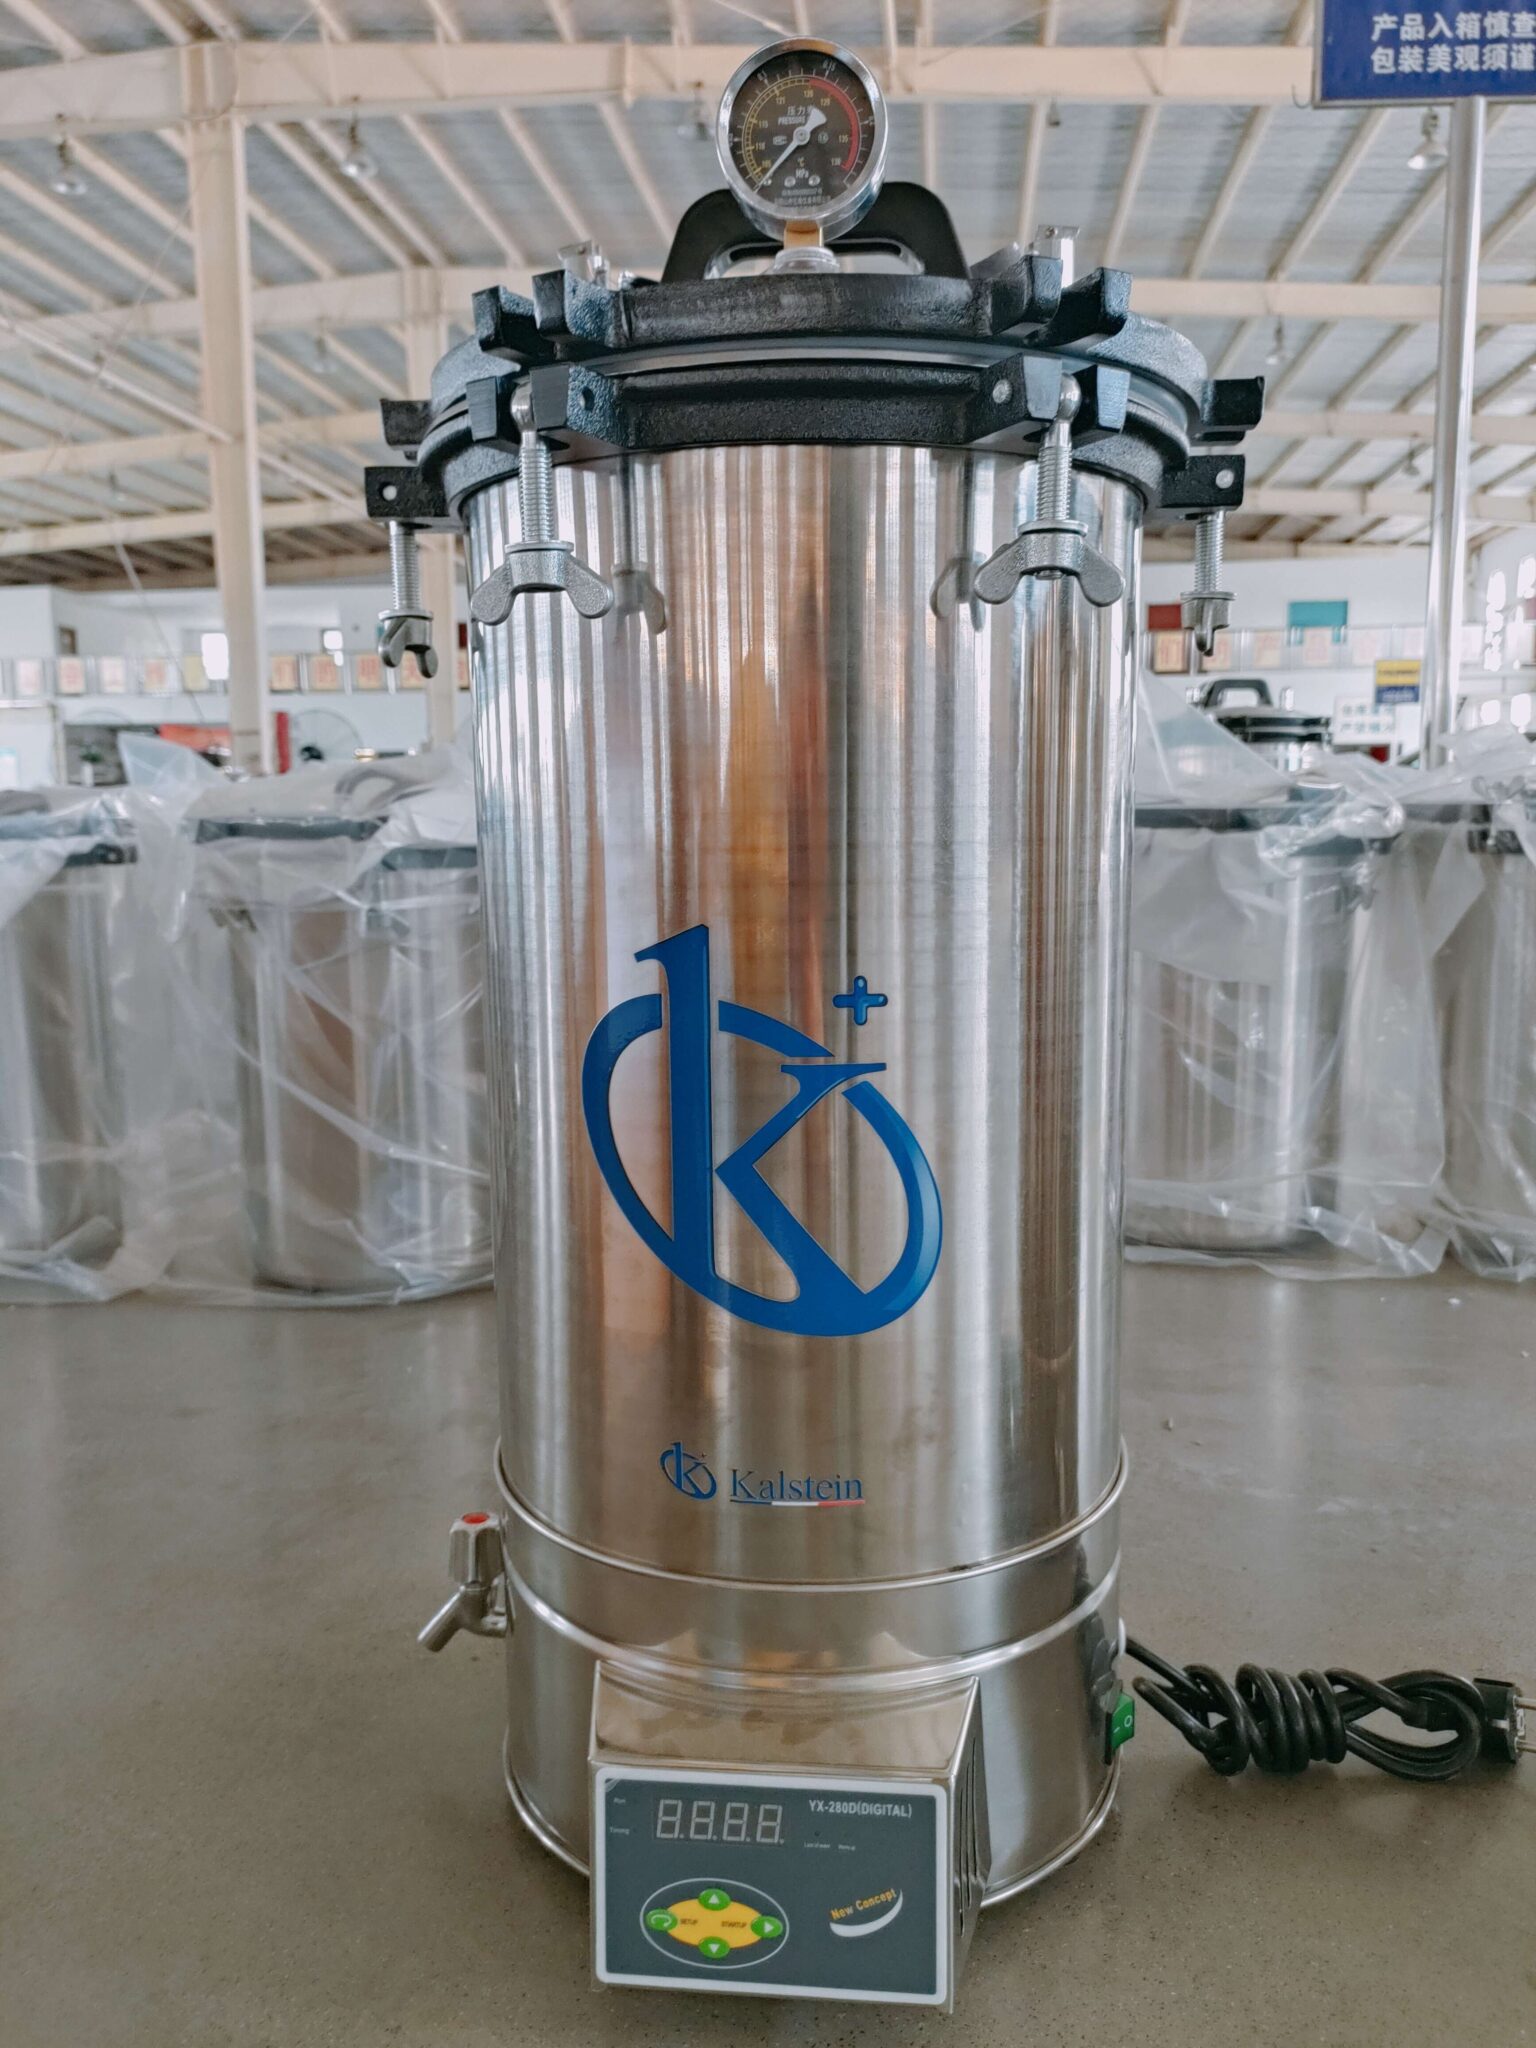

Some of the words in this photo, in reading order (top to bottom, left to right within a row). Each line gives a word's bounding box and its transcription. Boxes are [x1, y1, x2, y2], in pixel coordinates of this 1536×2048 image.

[788, 105, 812, 116] 压力
[731, 1469, 864, 1500] Kalstein
[809, 1799, 912, 1818] YX-280D(DIGITAL)
[831, 1906, 854, 1921] New
[855, 1888, 897, 1911] Concept
